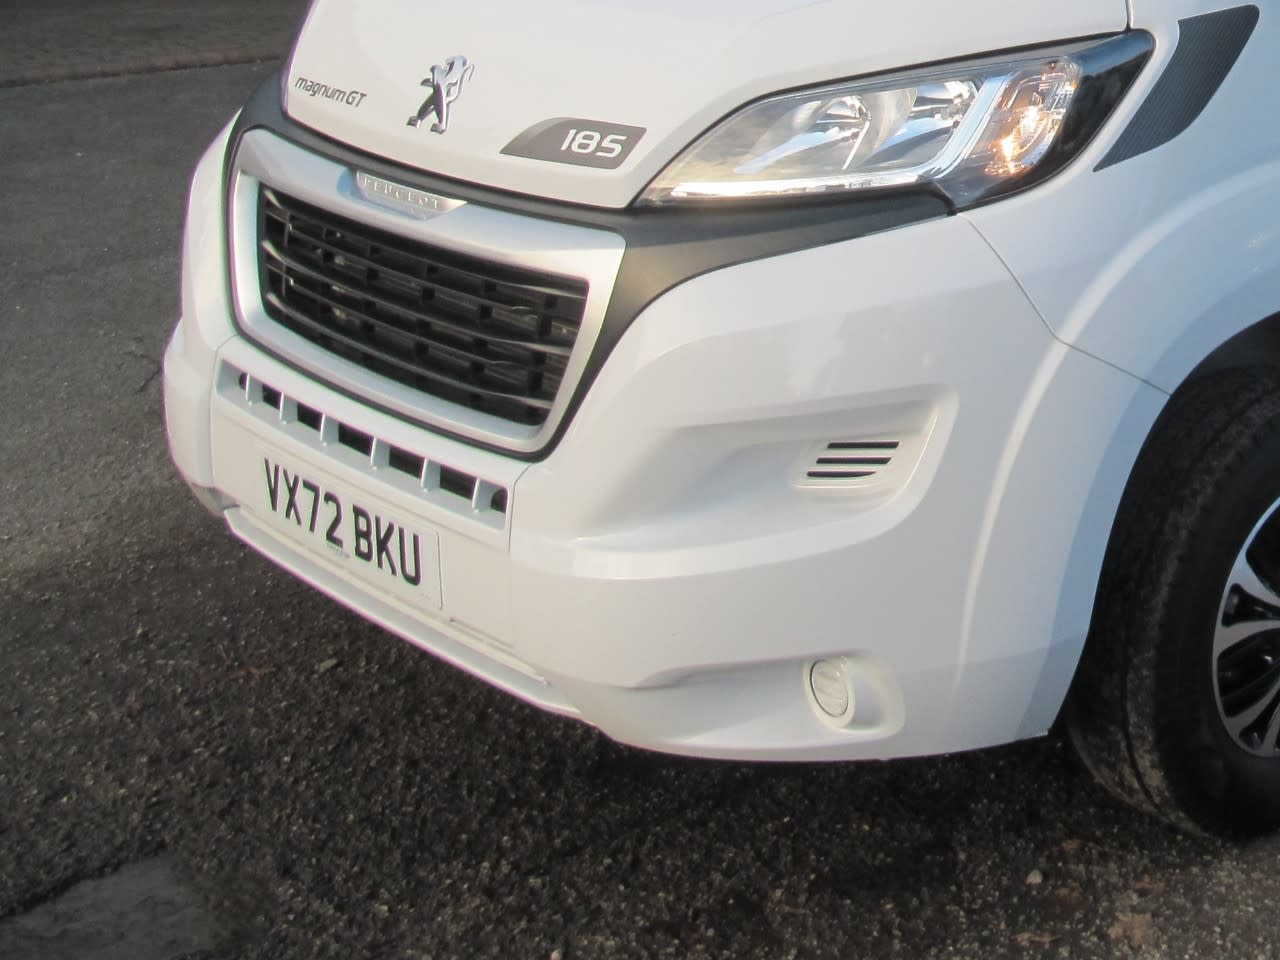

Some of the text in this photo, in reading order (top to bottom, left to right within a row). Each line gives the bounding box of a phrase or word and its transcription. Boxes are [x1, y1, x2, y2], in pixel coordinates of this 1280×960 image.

[560, 128, 628, 158] 185
[264, 456, 422, 587] VX72 BKU
